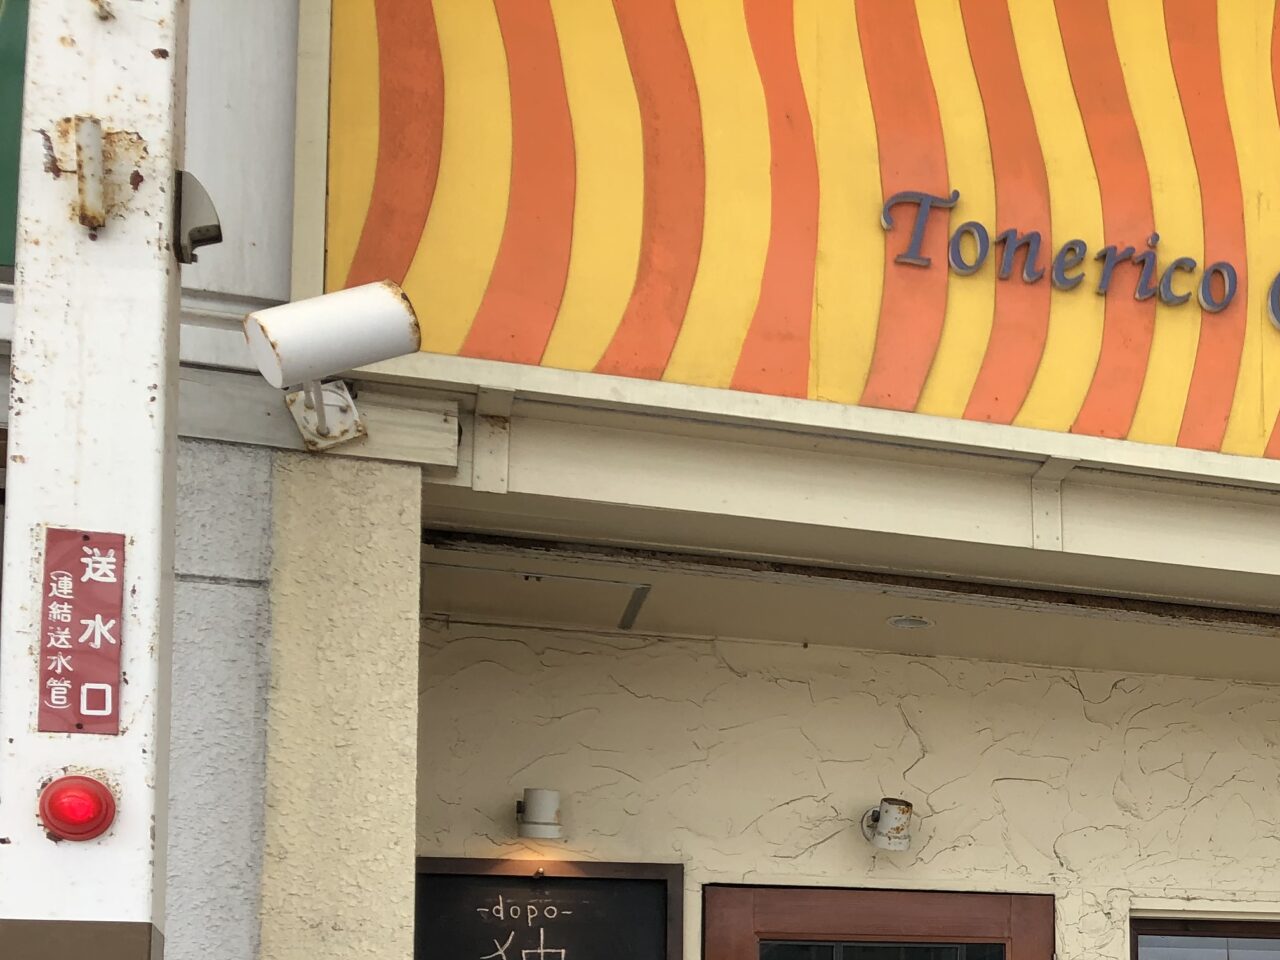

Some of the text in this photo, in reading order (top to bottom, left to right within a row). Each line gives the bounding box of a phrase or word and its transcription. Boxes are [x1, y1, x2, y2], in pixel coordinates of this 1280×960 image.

[881, 189, 1237, 313] Tonerico
[78, 546, 117, 716] 送水口
